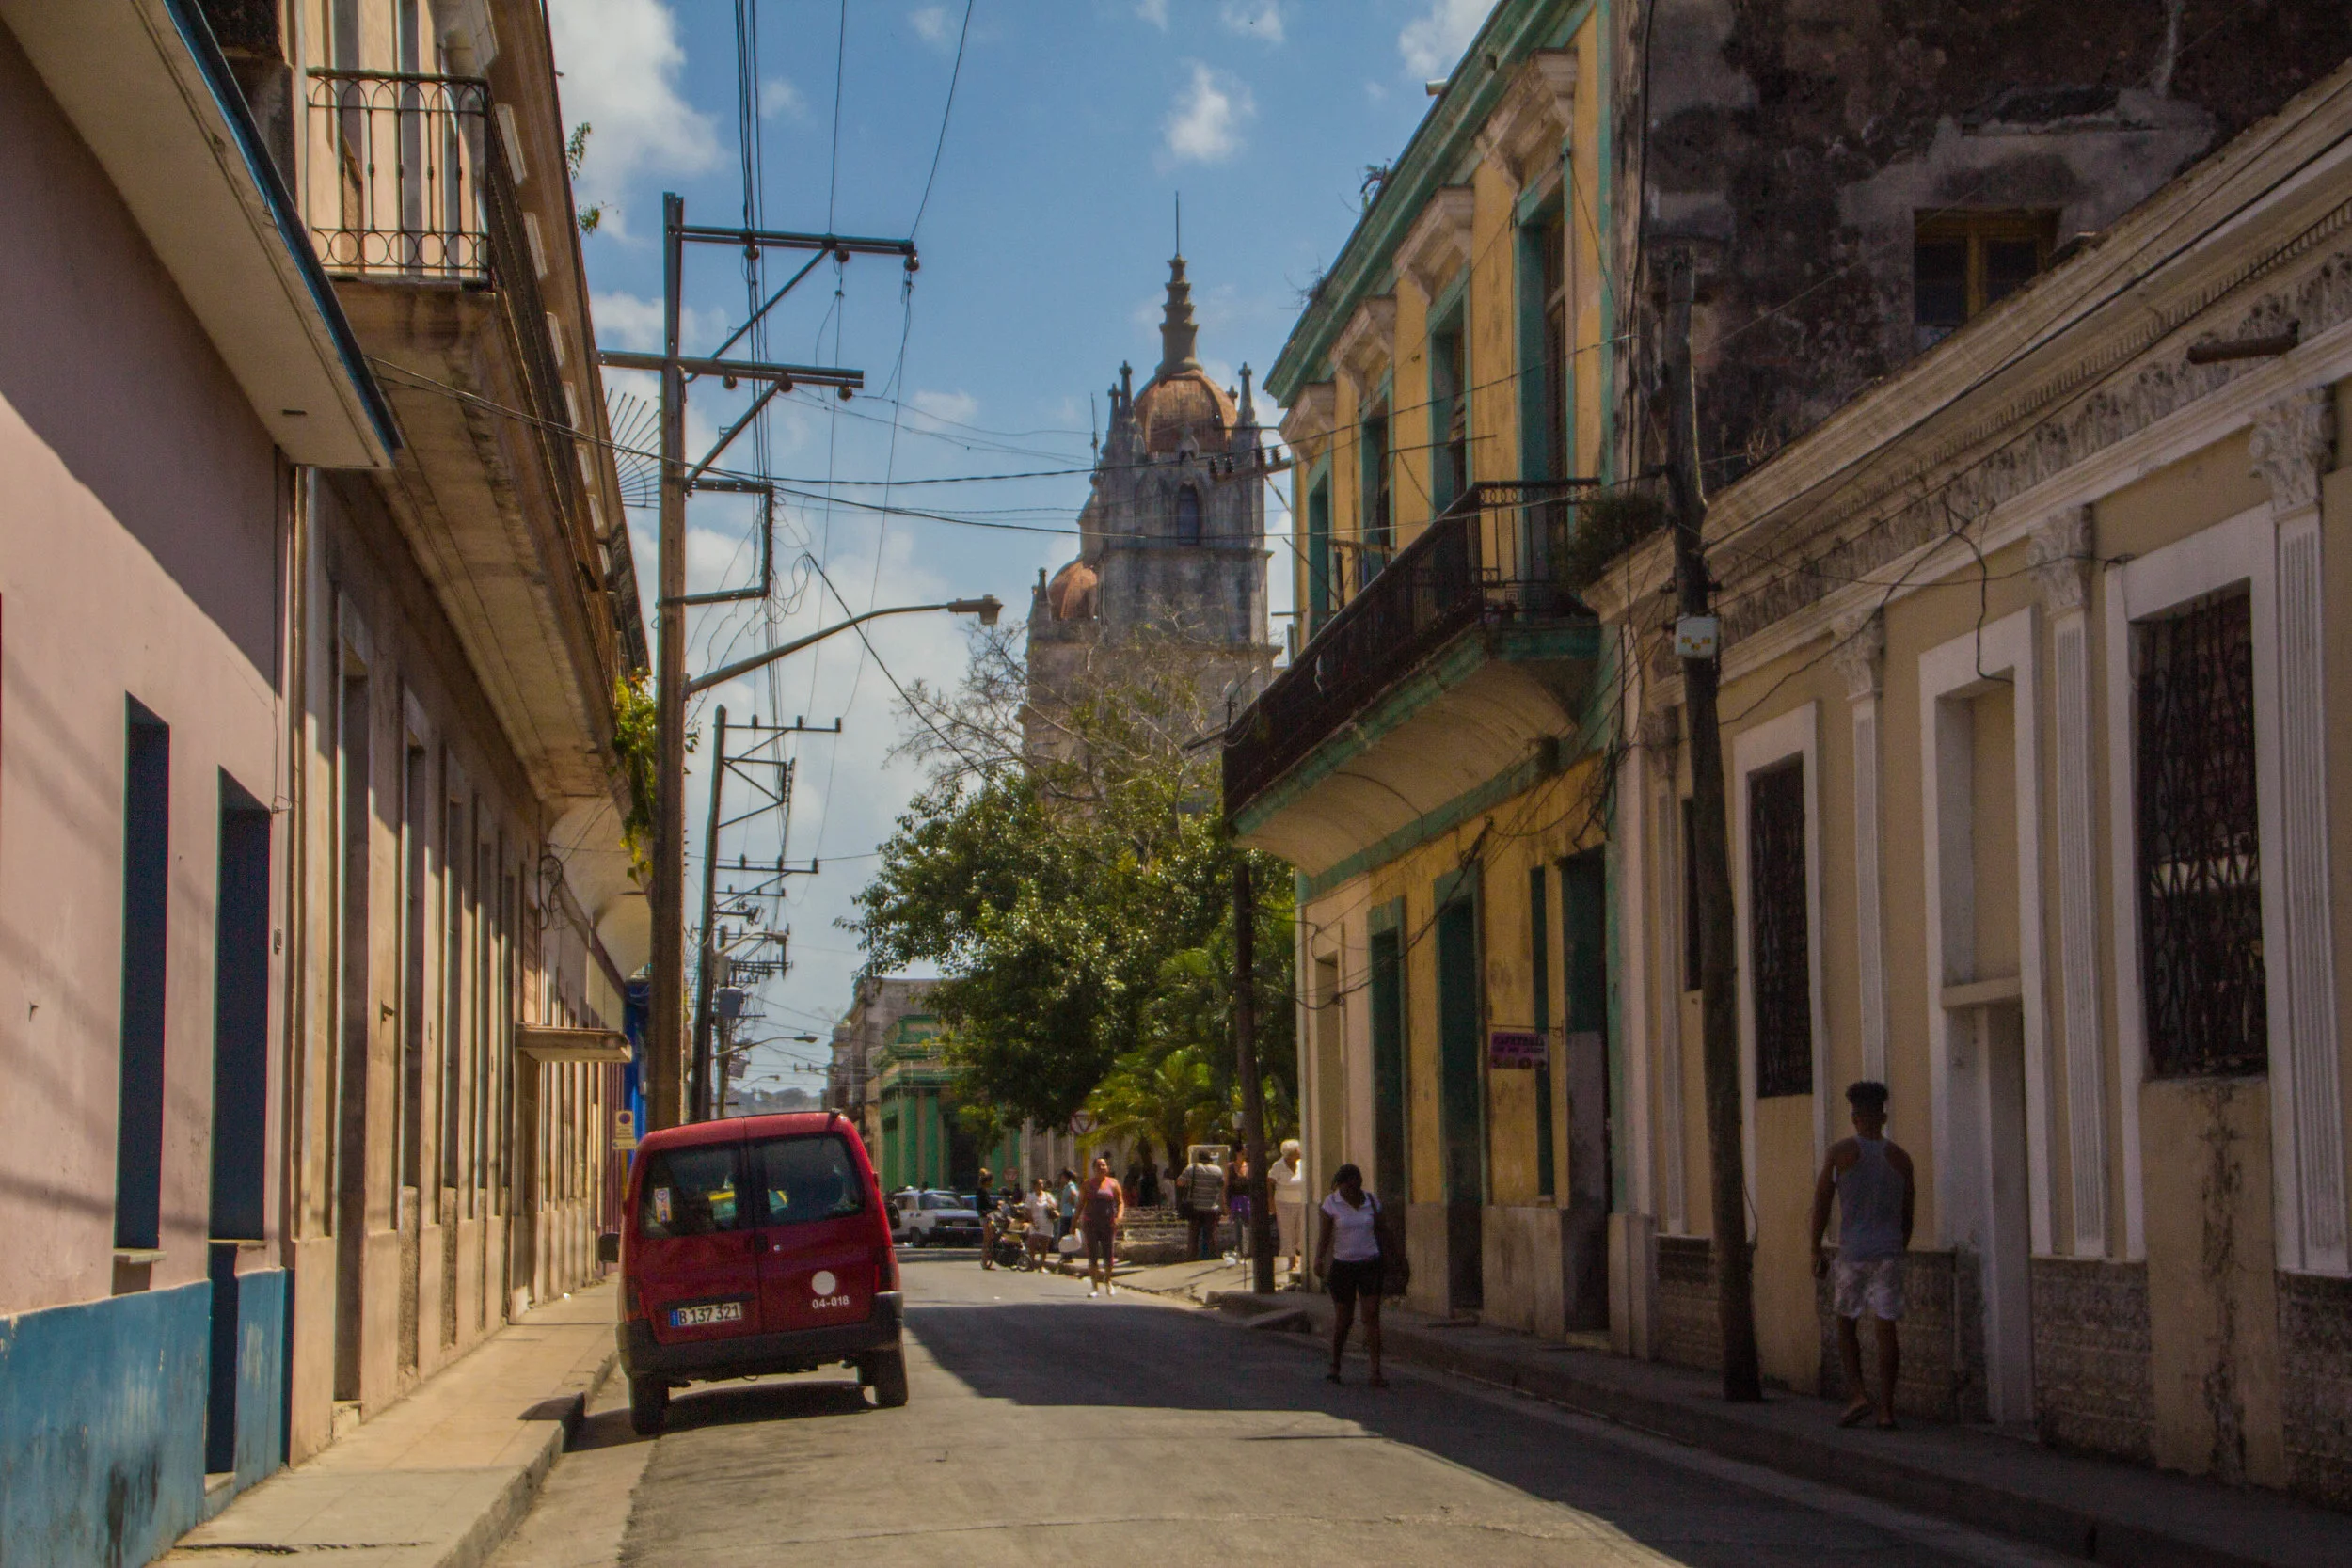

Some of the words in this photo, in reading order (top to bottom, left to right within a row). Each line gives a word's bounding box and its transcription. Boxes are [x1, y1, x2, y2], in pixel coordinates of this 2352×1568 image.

[812, 1294, 850, 1309] 04-018
[679, 1310, 688, 1325] B
[690, 1307, 714, 1323] 137
[716, 1304, 740, 1321] 321
